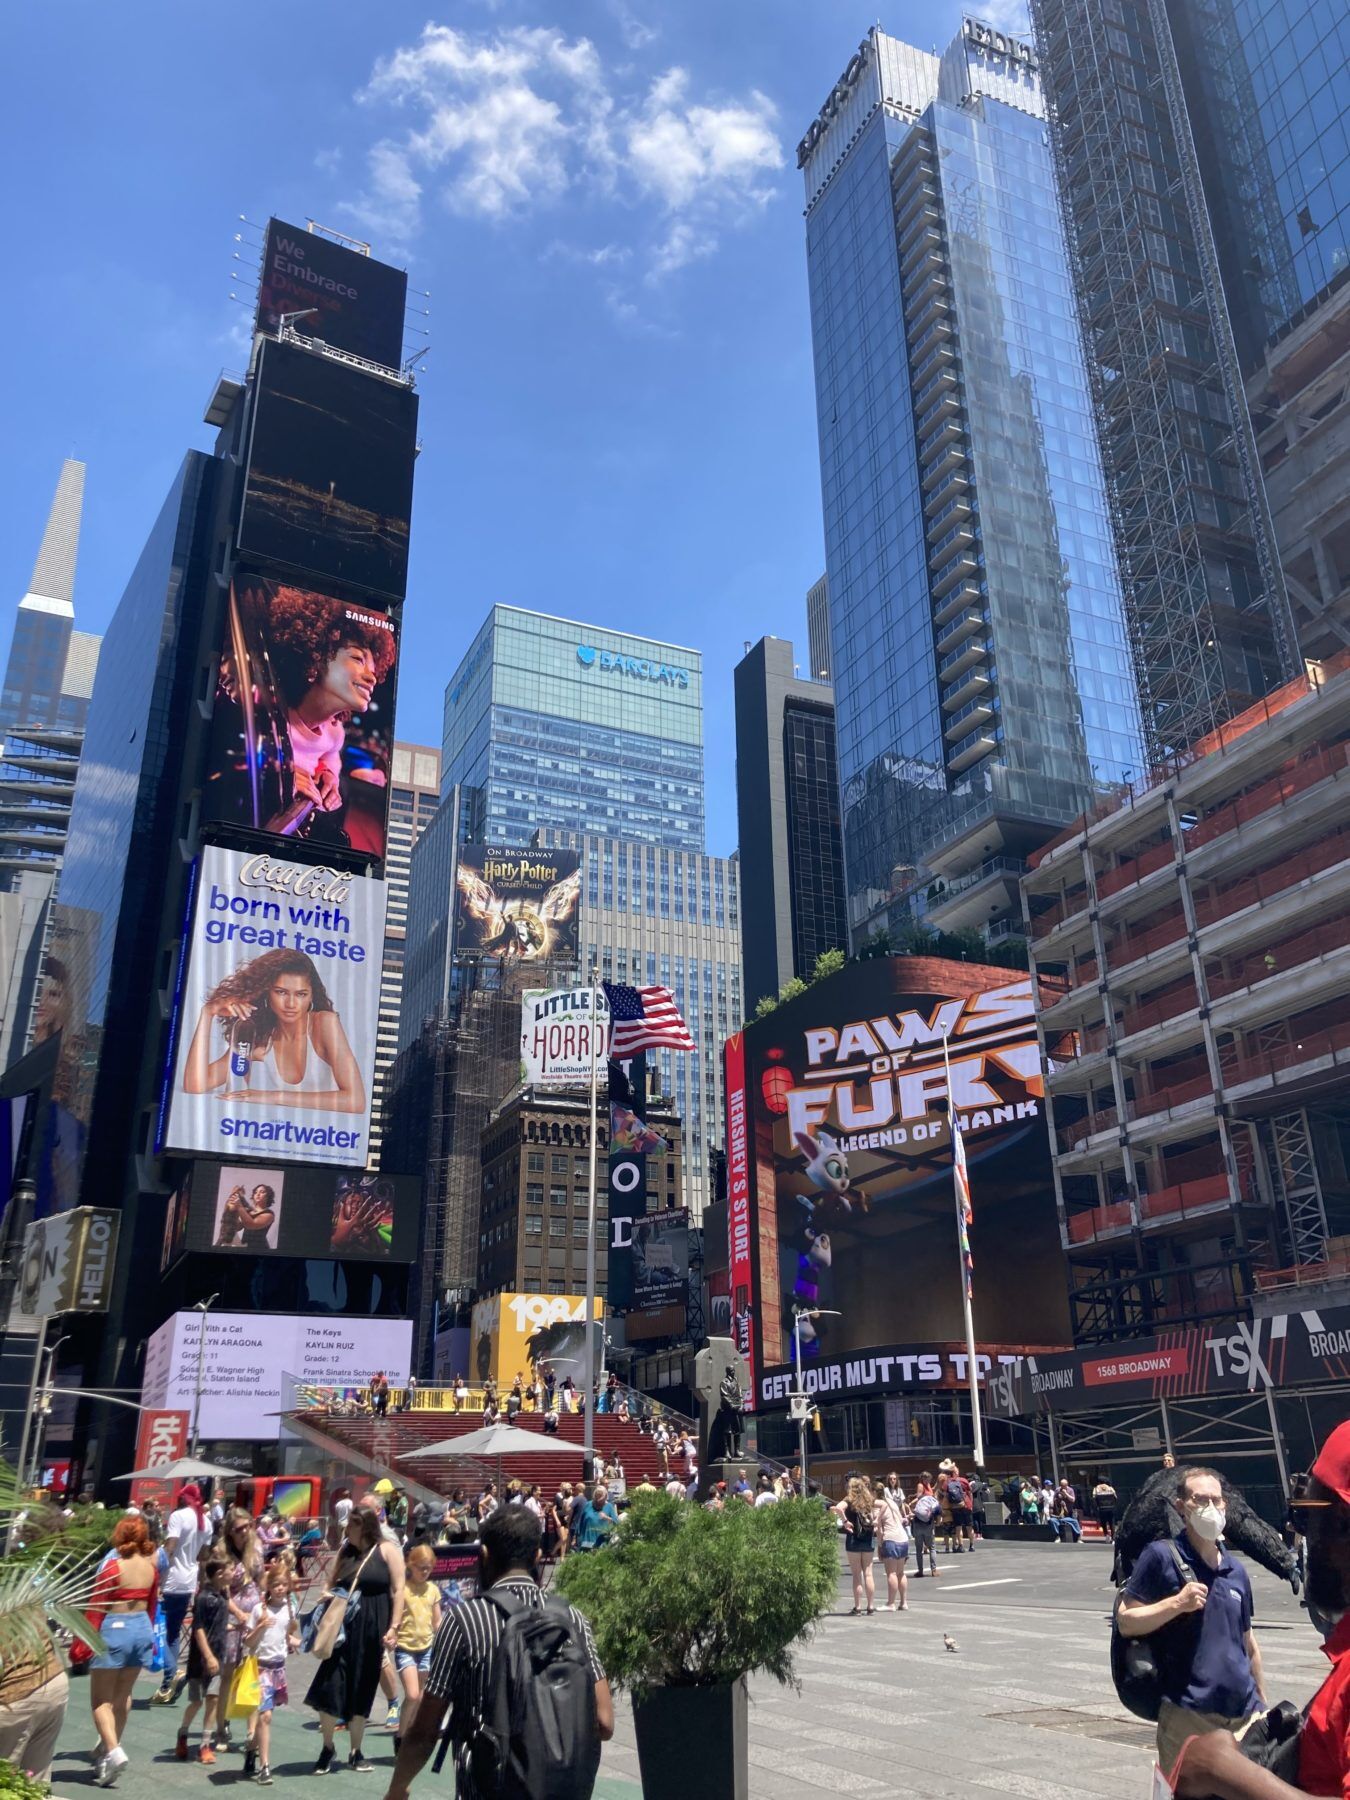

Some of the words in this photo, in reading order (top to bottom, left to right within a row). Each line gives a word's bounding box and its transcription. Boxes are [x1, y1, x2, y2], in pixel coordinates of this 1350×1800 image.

[276, 235, 305, 261] We
[273, 254, 358, 300] Embrace
[345, 610, 395, 632] SAMSUNG
[600, 650, 689, 686] BARCLAYS
[482, 860, 520, 882] Harry
[519, 860, 558, 882] Potter
[210, 884, 280, 921] born
[289, 903, 350, 934] with
[205, 919, 287, 950] great
[293, 931, 367, 963] taste
[535, 992, 590, 1022] LITTLE
[576, 1013, 587, 1021] OF
[804, 979, 1036, 1066] PAWS
[236, 1041, 249, 1073] smart
[871, 1051, 912, 1075] OF
[785, 1040, 1046, 1150] FURY
[219, 1117, 361, 1150] smartwater
[730, 1089, 747, 1195] HERSHEY'S
[841, 1127, 908, 1152] LEGEND
[913, 1121, 943, 1142] OF
[733, 1199, 749, 1264] STORE
[80, 1214, 112, 1305] HELLO!
[220, 1339, 263, 1347] ARAGONA
[229, 1325, 243, 1333] Cat
[307, 1328, 320, 1336] The
[323, 1328, 342, 1338] Keys
[305, 1341, 334, 1349] KAYLIN
[336, 1342, 355, 1350] RUIZ
[331, 1355, 340, 1363] 12
[1204, 1318, 1275, 1389] TSX
[303, 1368, 323, 1376] Frank
[326, 1369, 351, 1377] Sinatra
[762, 1374, 793, 1401] GET
[793, 1368, 842, 1394] YOUR
[846, 1354, 942, 1386] MUTTS
[1096, 1363, 1117, 1378] 1568
[1118, 1356, 1172, 1375] BROADWAY
[989, 1363, 1020, 1418] TSX
[1030, 1368, 1074, 1394] BROADWAY
[148, 1416, 182, 1470] tkts
